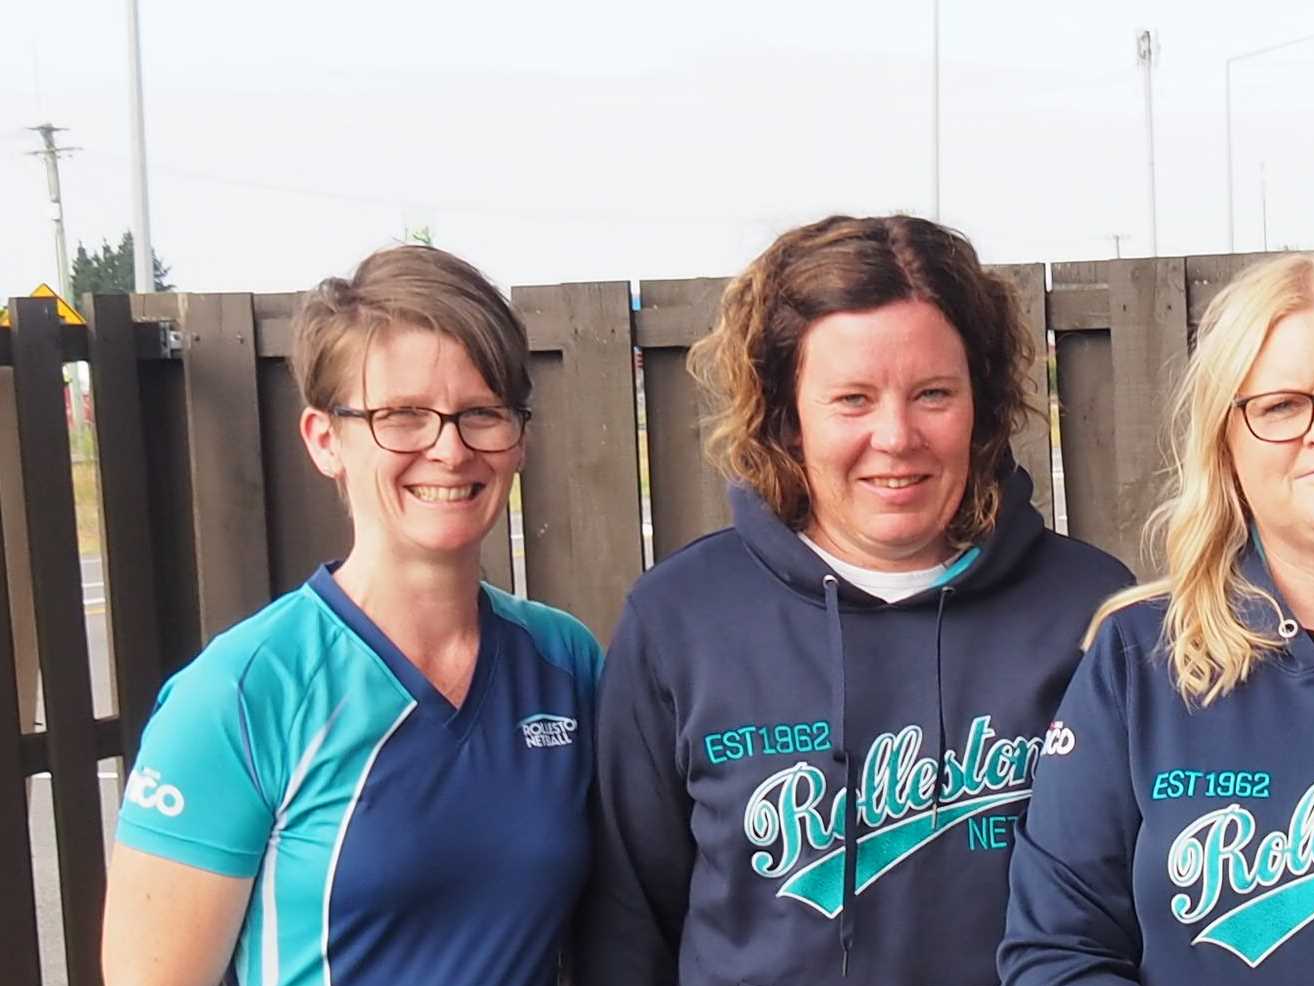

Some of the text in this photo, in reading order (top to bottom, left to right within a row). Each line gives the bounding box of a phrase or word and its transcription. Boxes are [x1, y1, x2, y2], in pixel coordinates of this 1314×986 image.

[704, 726, 756, 764] EST
[1152, 770, 1272, 800] EST 1962
